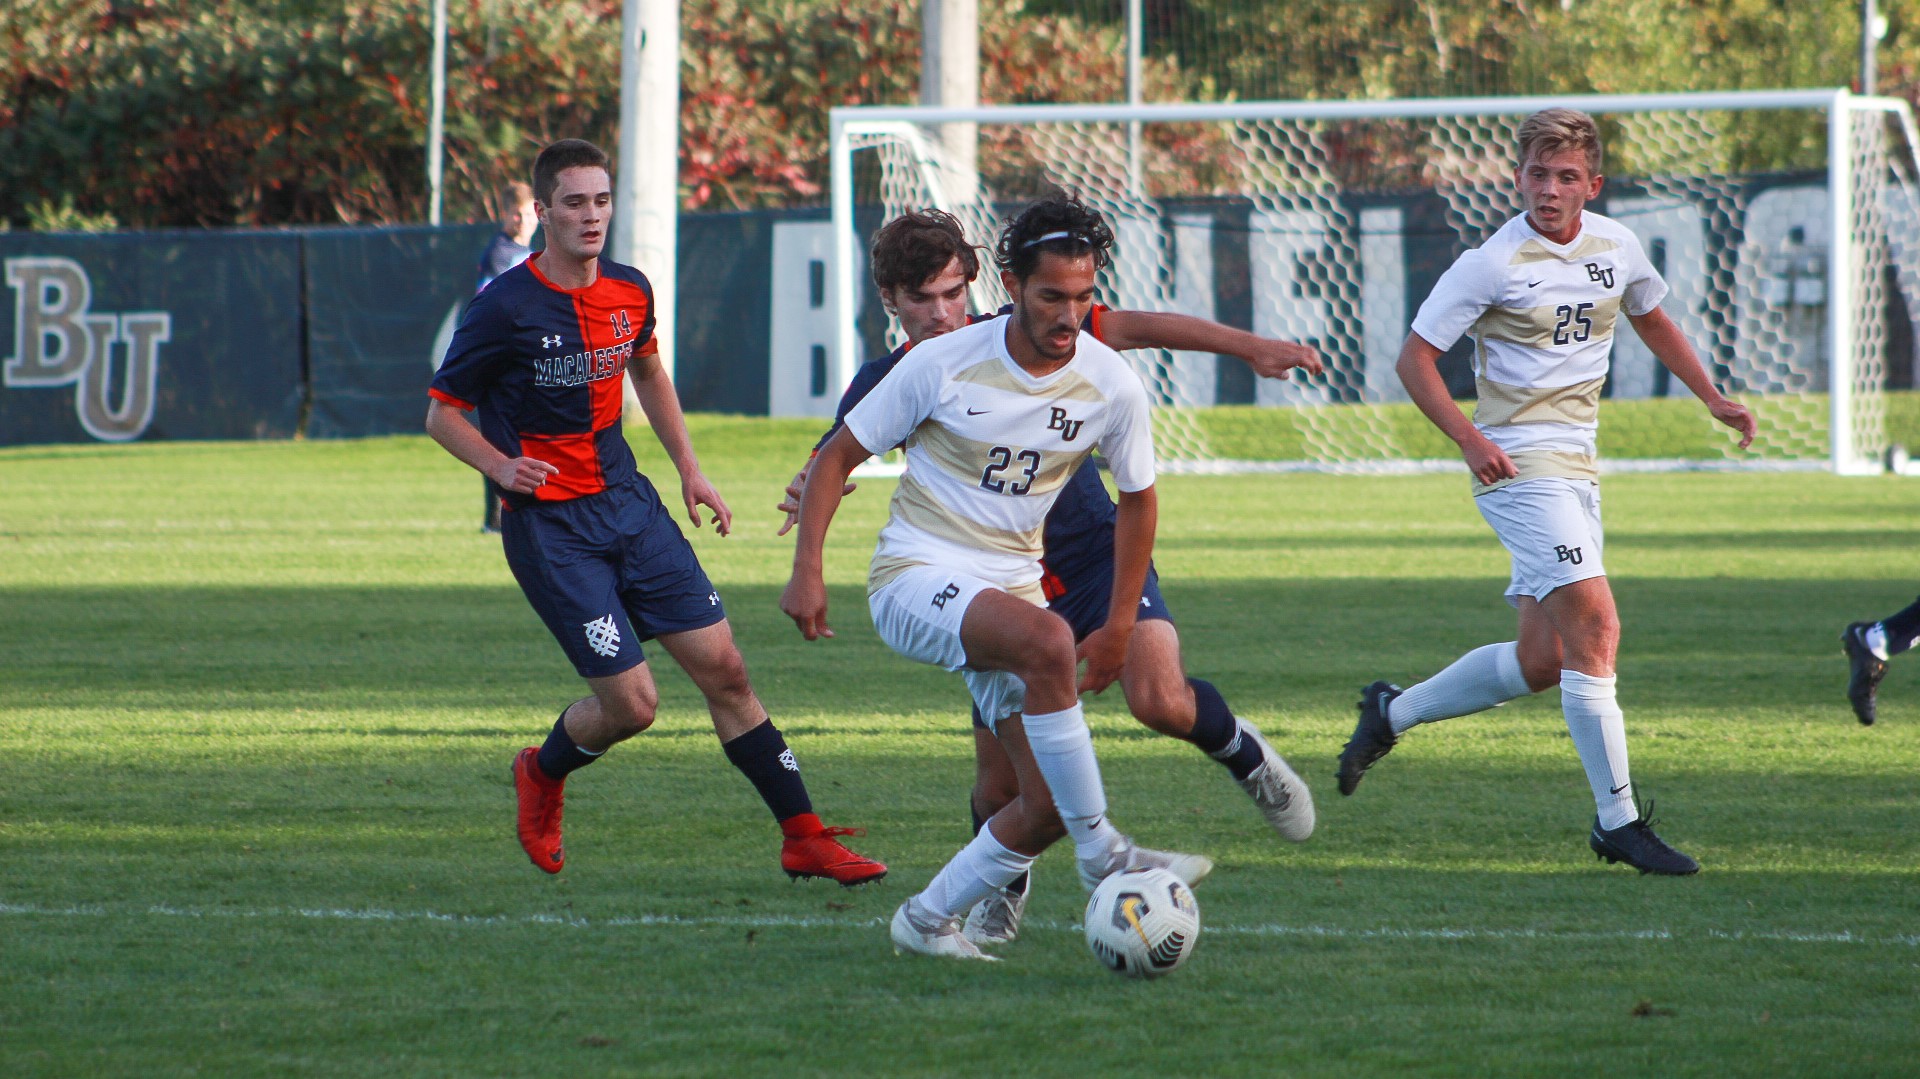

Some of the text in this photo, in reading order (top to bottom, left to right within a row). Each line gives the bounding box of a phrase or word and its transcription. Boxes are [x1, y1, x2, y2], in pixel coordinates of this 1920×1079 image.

[1585, 262, 1615, 289] BU
[610, 309, 632, 339] 14
[1553, 302, 1594, 346] 25
[3, 256, 171, 441] BU
[1047, 406, 1085, 442] BU
[979, 445, 1041, 496] 23
[1553, 544, 1583, 565] BU
[931, 582, 960, 612] BU
